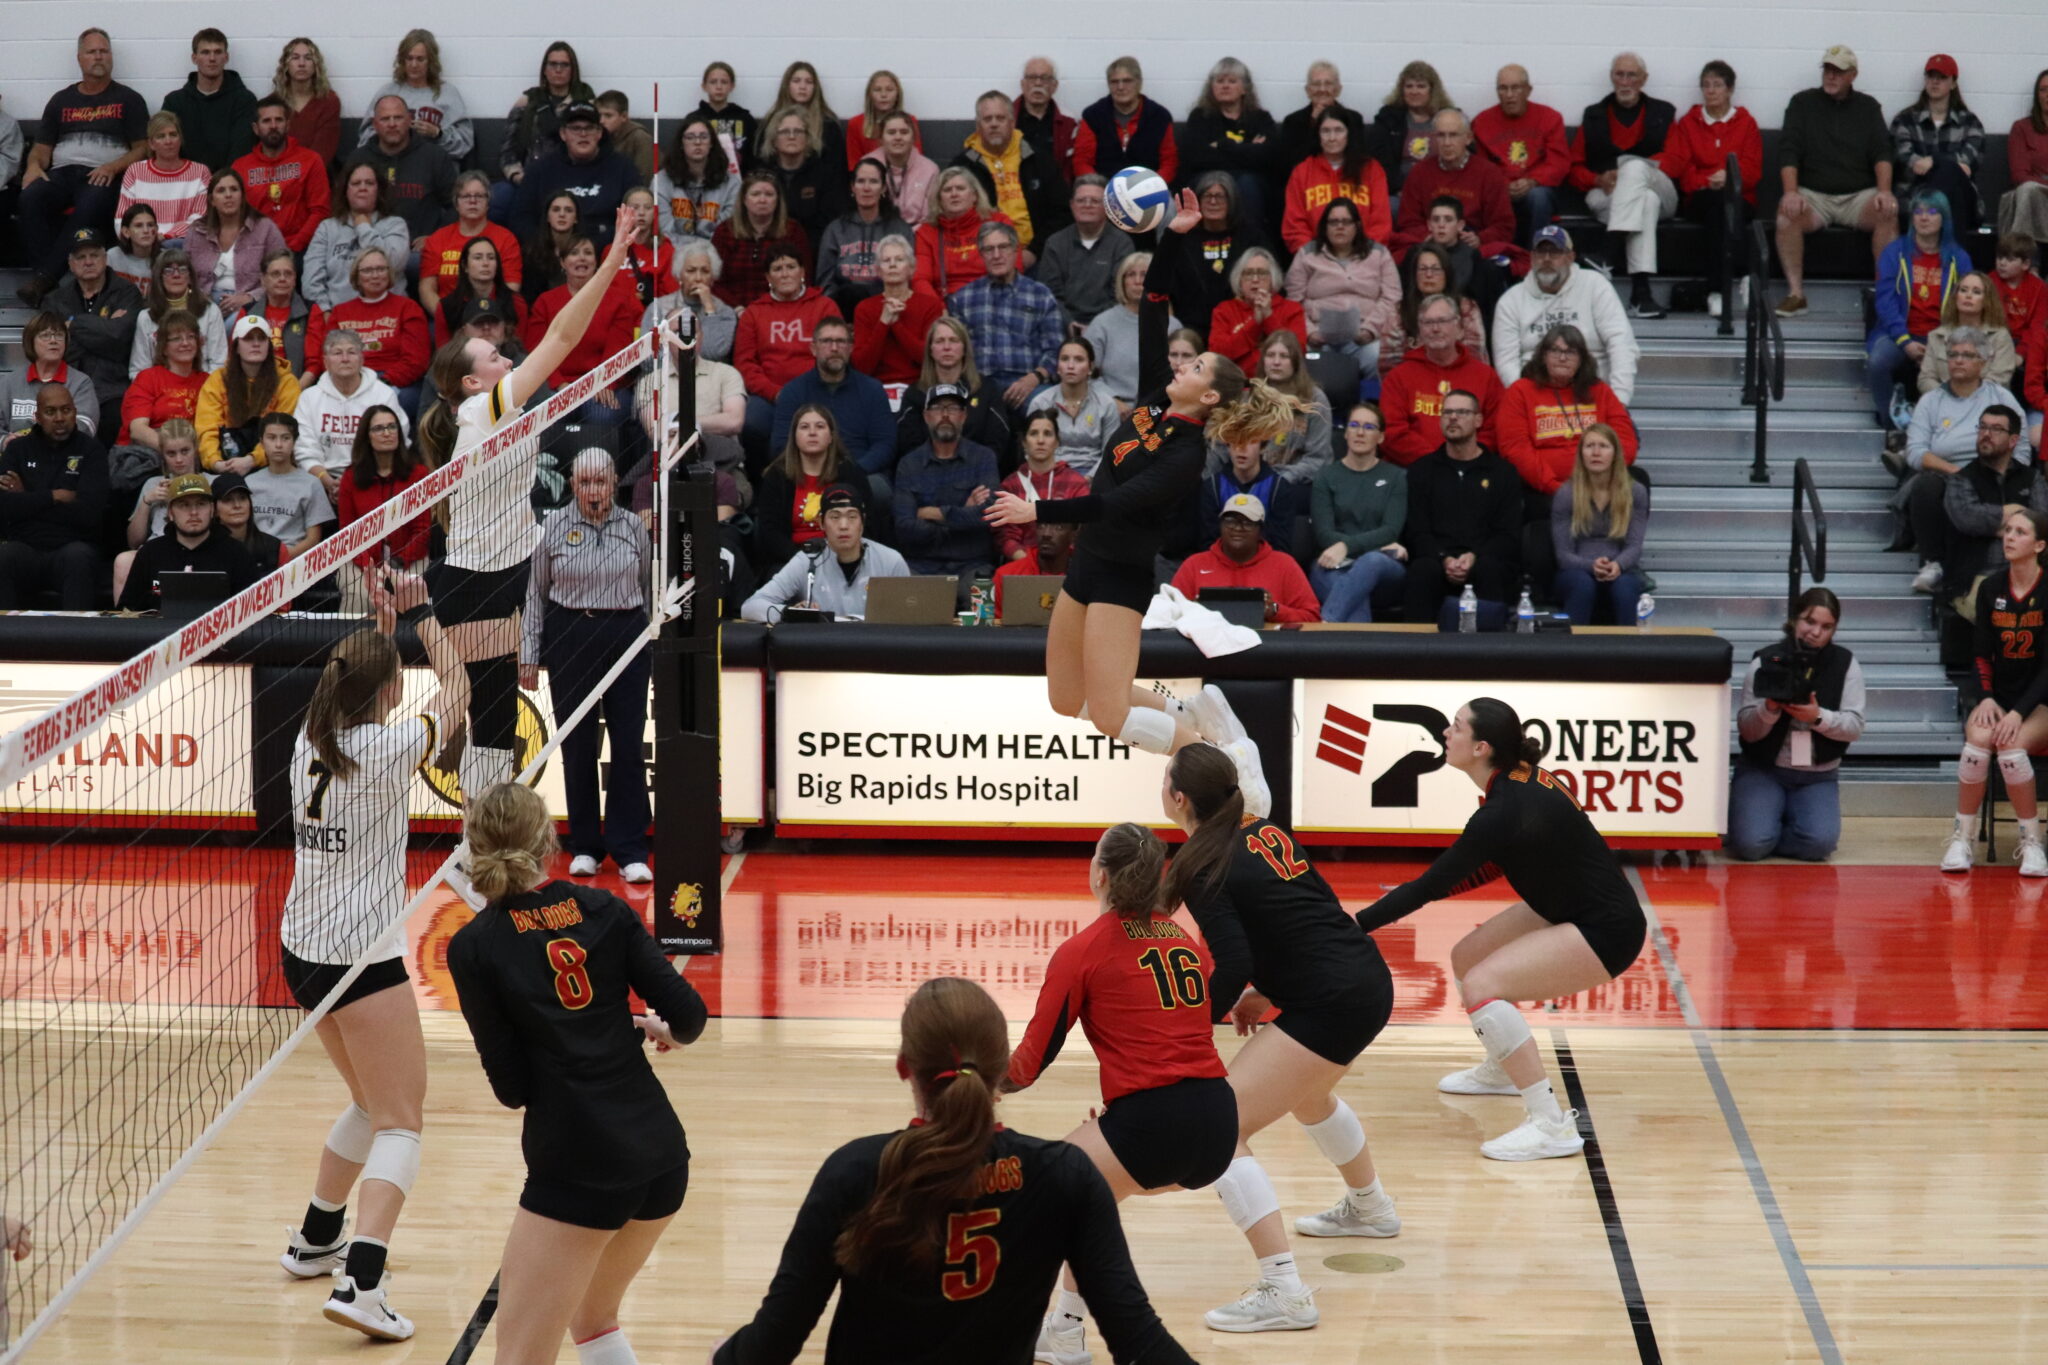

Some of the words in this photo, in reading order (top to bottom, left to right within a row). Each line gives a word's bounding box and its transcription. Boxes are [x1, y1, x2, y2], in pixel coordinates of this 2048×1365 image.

[248, 162, 301, 186] BULLDOGS
[321, 412, 362, 434] FERR
[253, 505, 296, 517] OLLEYBALL
[2001, 630, 2035, 659] 22
[22, 709, 62, 768] FERRIS
[64, 688, 97, 741] STATE
[798, 731, 987, 759] SPECTRUM
[997, 734, 1130, 761] HEALTH
[1522, 718, 1699, 764] ONEER
[57, 732, 199, 768] LAND
[308, 759, 334, 821] 7
[798, 773, 842, 805] Big
[850, 773, 948, 806] Rapids
[957, 775, 1078, 807] Hospital
[1550, 768, 1684, 814] ORTS
[296, 821, 347, 853] HUSKIES
[1246, 825, 1309, 881] 12
[509, 897, 583, 934] BULLDOGS
[546, 937, 594, 1010] 8
[1137, 946, 1207, 1010] 16
[941, 1207, 1001, 1301] 5
